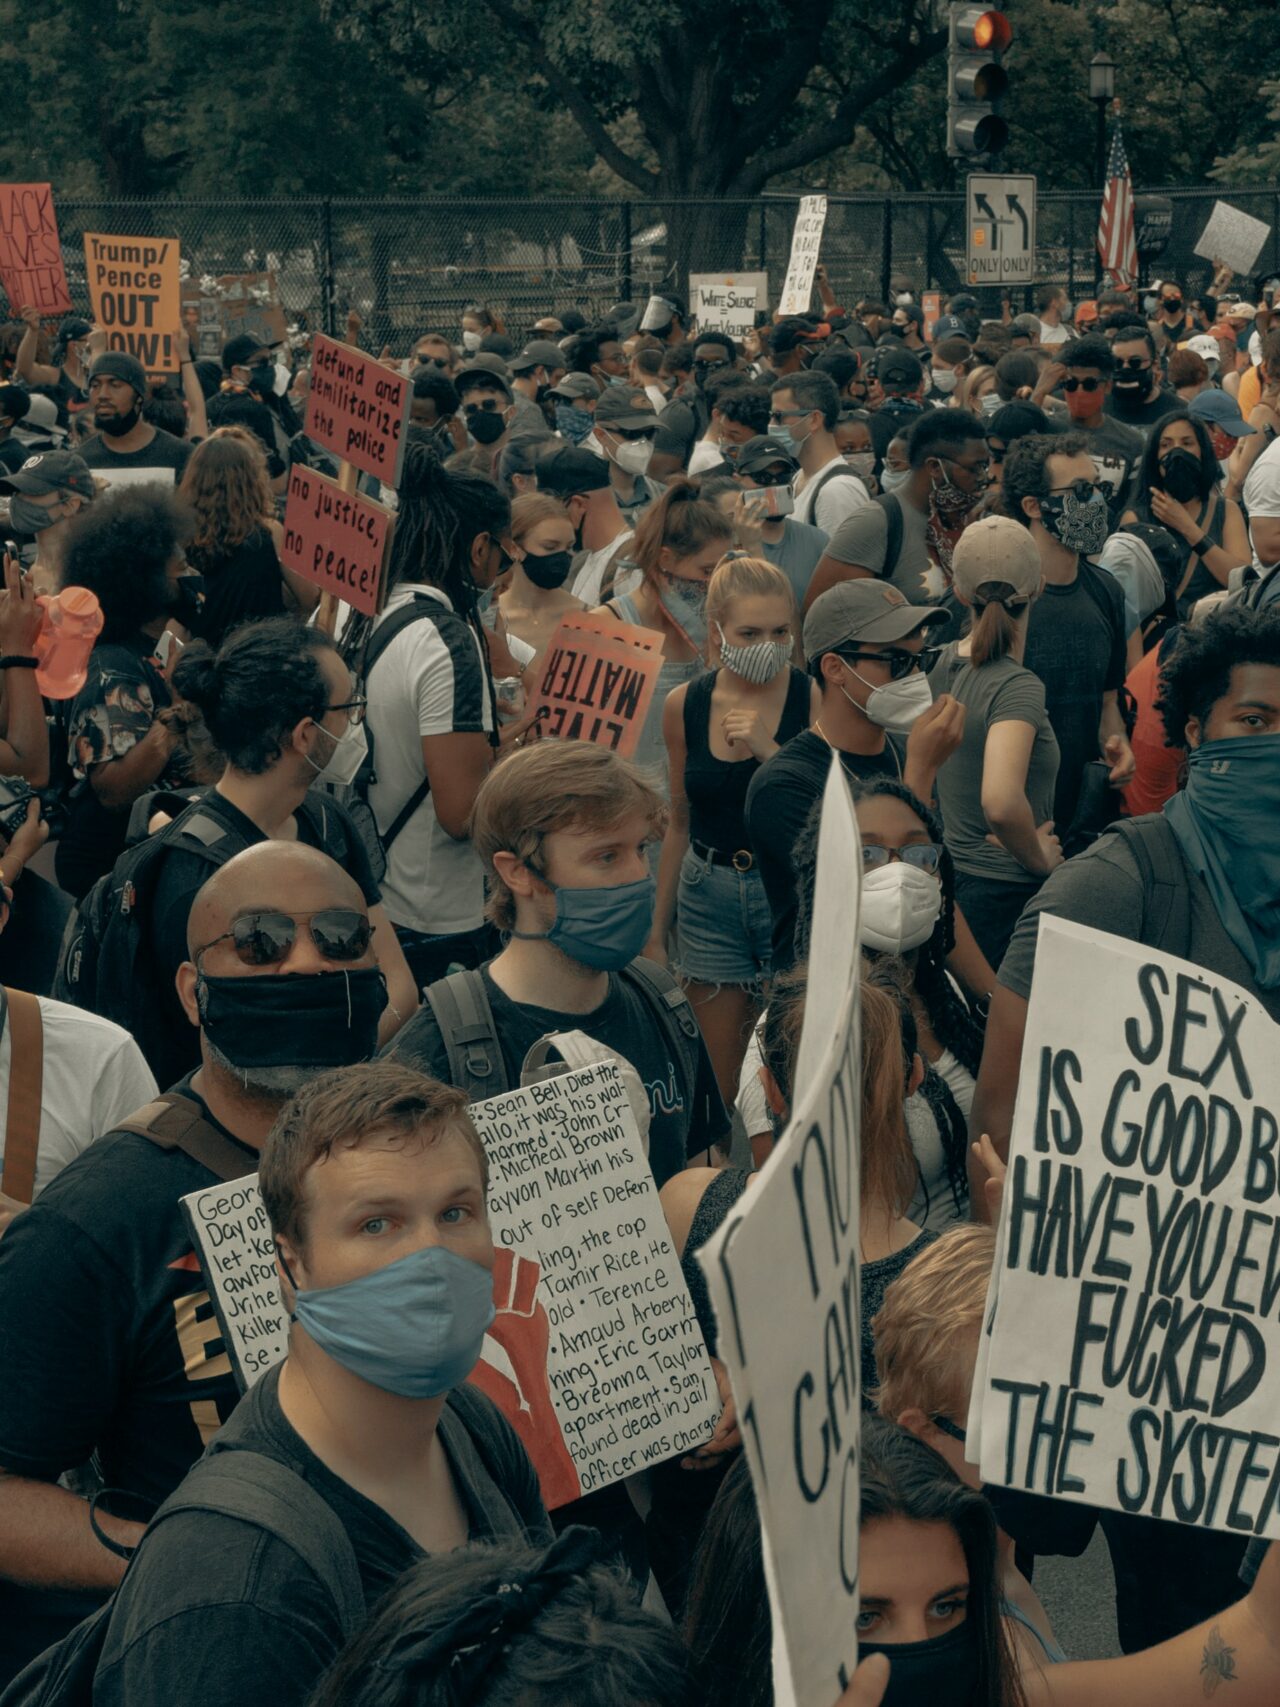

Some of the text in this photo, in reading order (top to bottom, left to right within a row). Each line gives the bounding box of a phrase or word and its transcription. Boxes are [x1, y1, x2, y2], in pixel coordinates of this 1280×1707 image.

[0, 190, 55, 234] LACK
[0, 233, 60, 267] IVES
[91, 238, 168, 269] Trump/
[96, 264, 162, 289] Pence
[971, 257, 1031, 273] ONLY ONLY
[101, 291, 160, 328] OUT
[105, 331, 172, 367] OW!
[316, 345, 400, 407] defund and
[310, 373, 400, 440] demilitarize
[314, 409, 385, 463] the police
[290, 475, 380, 548] no justice,
[285, 529, 377, 598] no peace!
[541, 648, 645, 720] MATTER
[1125, 962, 1253, 1101] SEX
[483, 1094, 527, 1121] Sean
[567, 1071, 595, 1093] Died
[596, 1063, 620, 1084] the
[479, 1121, 518, 1148] allo,
[532, 1103, 568, 1127] was
[569, 1095, 596, 1114] his
[487, 1130, 549, 1165] narmed
[555, 1112, 601, 1140] John
[1033, 1045, 1082, 1156] IS
[1101, 1068, 1242, 1195] GOOD
[499, 1124, 625, 1183] Micheal Brown
[489, 1148, 634, 1215] ayvon Martin his
[205, 1206, 268, 1247] Day of
[541, 1204, 562, 1230] of
[565, 1192, 600, 1218] self
[581, 1229, 612, 1252] the
[616, 1217, 646, 1240] cop
[1006, 1155, 1143, 1281] HAVE
[1142, 1183, 1233, 1302] YOU
[212, 1237, 275, 1274] let Ke
[222, 1260, 280, 1294] awfor
[540, 1263, 600, 1298] Tamir
[649, 1239, 671, 1258] He
[589, 1268, 670, 1309] Terence
[549, 1361, 598, 1390] ning
[598, 1338, 639, 1367] Eric
[1070, 1281, 1267, 1418] FUCKED
[561, 1342, 705, 1412] Breonna Taylor
[563, 1386, 662, 1444] apartment
[569, 1381, 709, 1465] found dead in jail
[991, 1377, 1105, 1495] THE
[580, 1449, 638, 1490] officer
[641, 1437, 671, 1461] was
